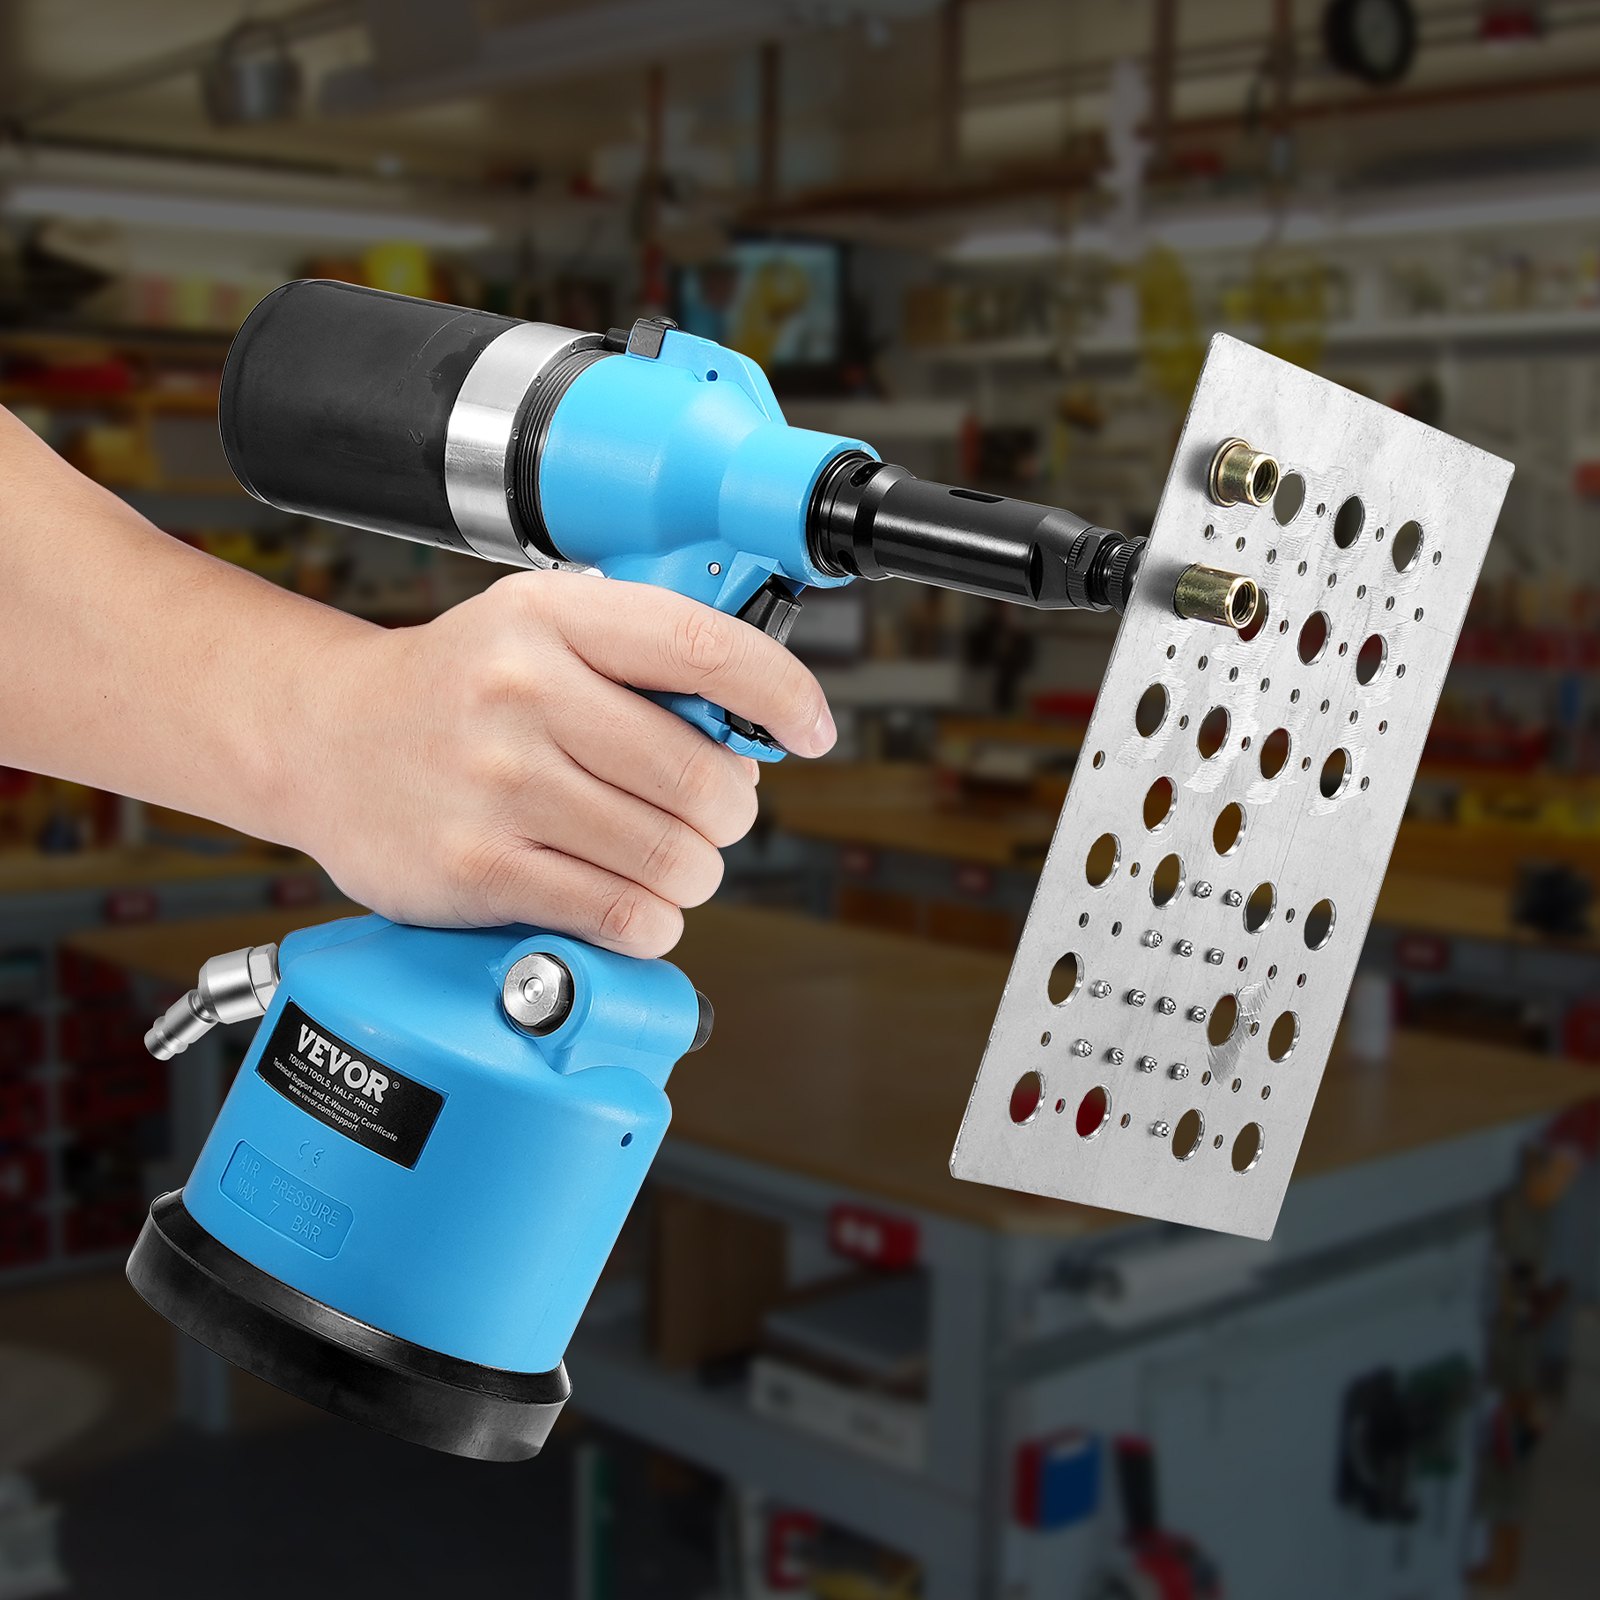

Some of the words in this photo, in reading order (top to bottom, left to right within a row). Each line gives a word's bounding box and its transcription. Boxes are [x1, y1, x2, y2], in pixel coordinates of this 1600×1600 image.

[273, 1057, 293, 1079] Technical
[291, 1073, 313, 1094] Support
[311, 1088, 326, 1101] and
[324, 1094, 361, 1123] E-Warranty
[360, 1117, 398, 1142] Certificate
[289, 1053, 309, 1073] TOUGH
[308, 1067, 332, 1090] TOOLS,
[332, 1084, 354, 1101] HALF
[353, 1096, 380, 1117] PRICE
[235, 1177, 259, 1204] MAX
[267, 1200, 280, 1216] 7
[291, 1214, 322, 1244] BAR
[238, 1154, 261, 1179] AIR
[269, 1175, 341, 1228] PRESSURE
